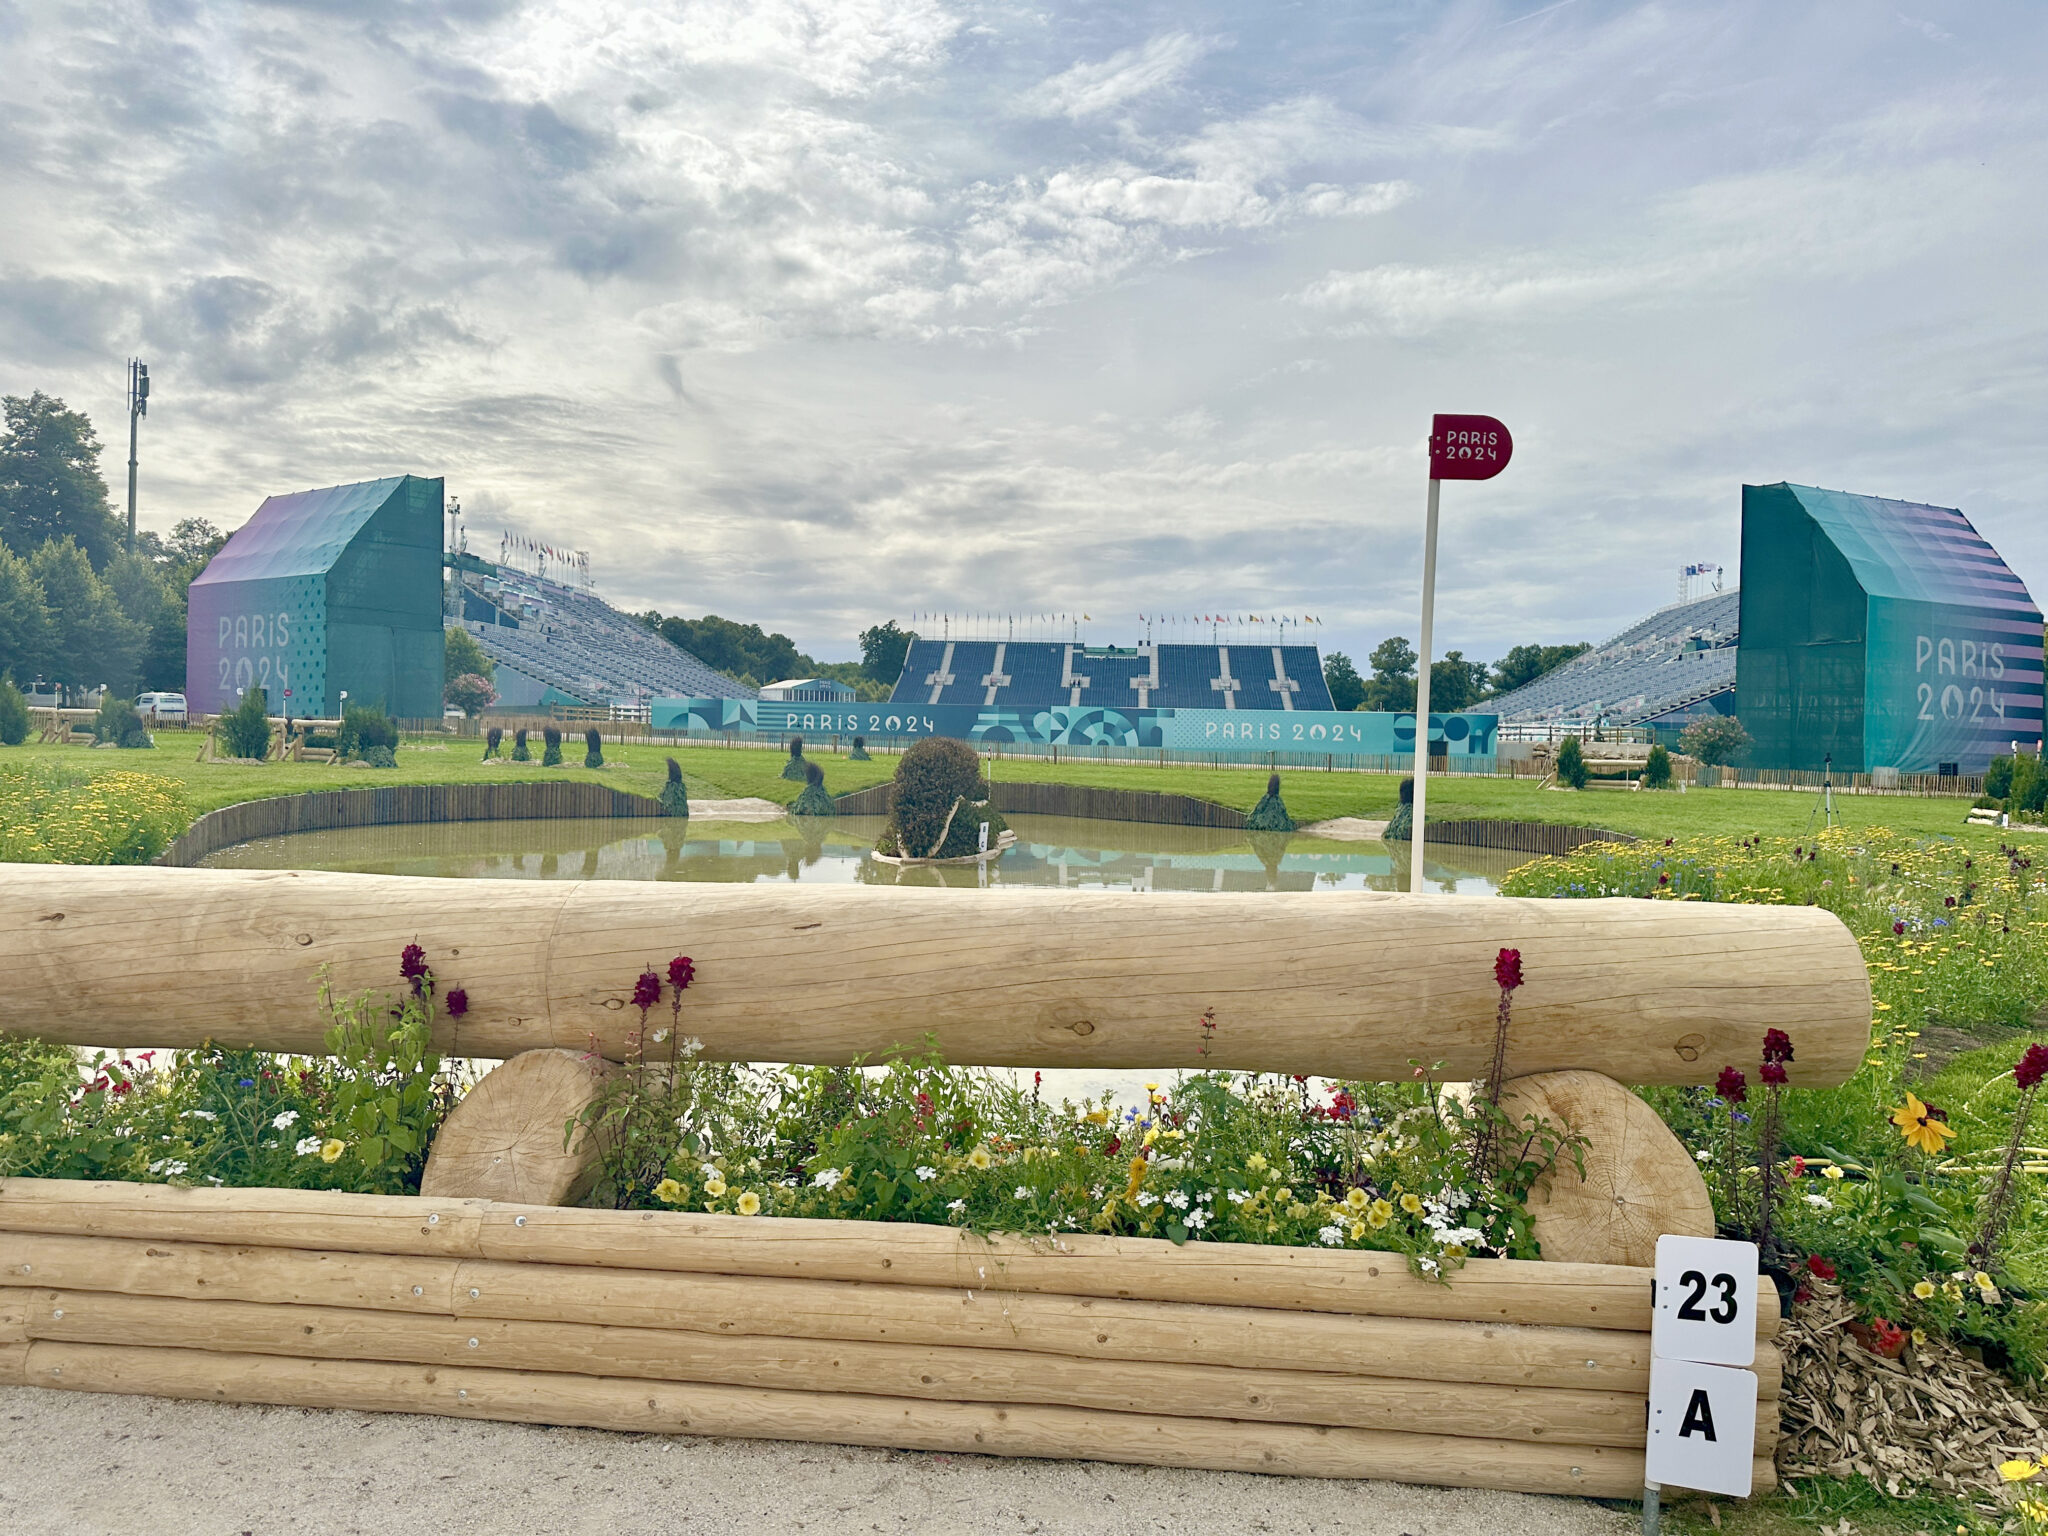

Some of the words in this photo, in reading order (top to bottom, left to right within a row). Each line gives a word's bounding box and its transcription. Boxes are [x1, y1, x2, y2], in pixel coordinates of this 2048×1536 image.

[1446, 446, 1497, 461] 2024
[218, 655, 289, 691] 2024
[1917, 683, 2005, 725] 2024
[869, 714, 934, 733] 2024
[1292, 723, 1361, 742] 2024
[1677, 1270, 1738, 1324] 23
[1678, 1388, 1717, 1442] A
